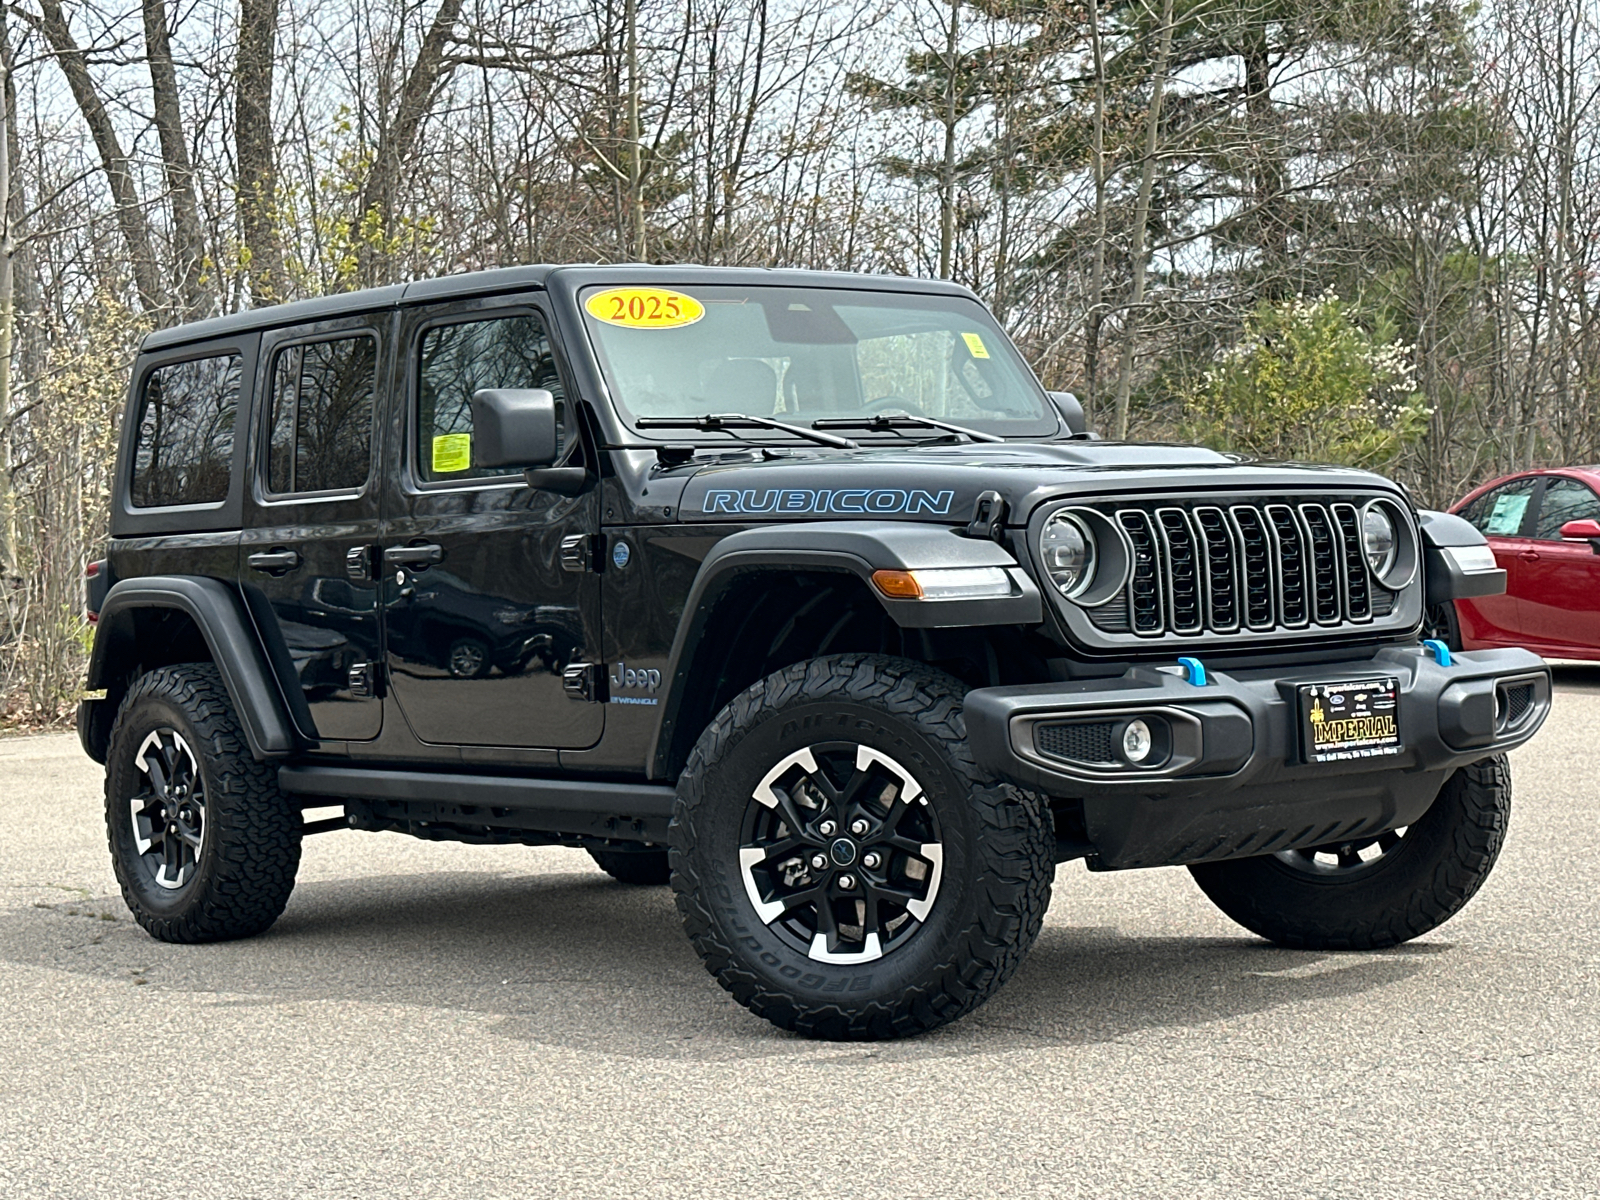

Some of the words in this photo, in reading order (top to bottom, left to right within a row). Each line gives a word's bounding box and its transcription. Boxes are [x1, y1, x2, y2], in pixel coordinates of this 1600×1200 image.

[609, 296, 680, 320] 2025
[701, 489, 955, 514] RUBICON
[610, 662, 662, 694] Jeep
[1314, 715, 1397, 743] IMPERIAL
